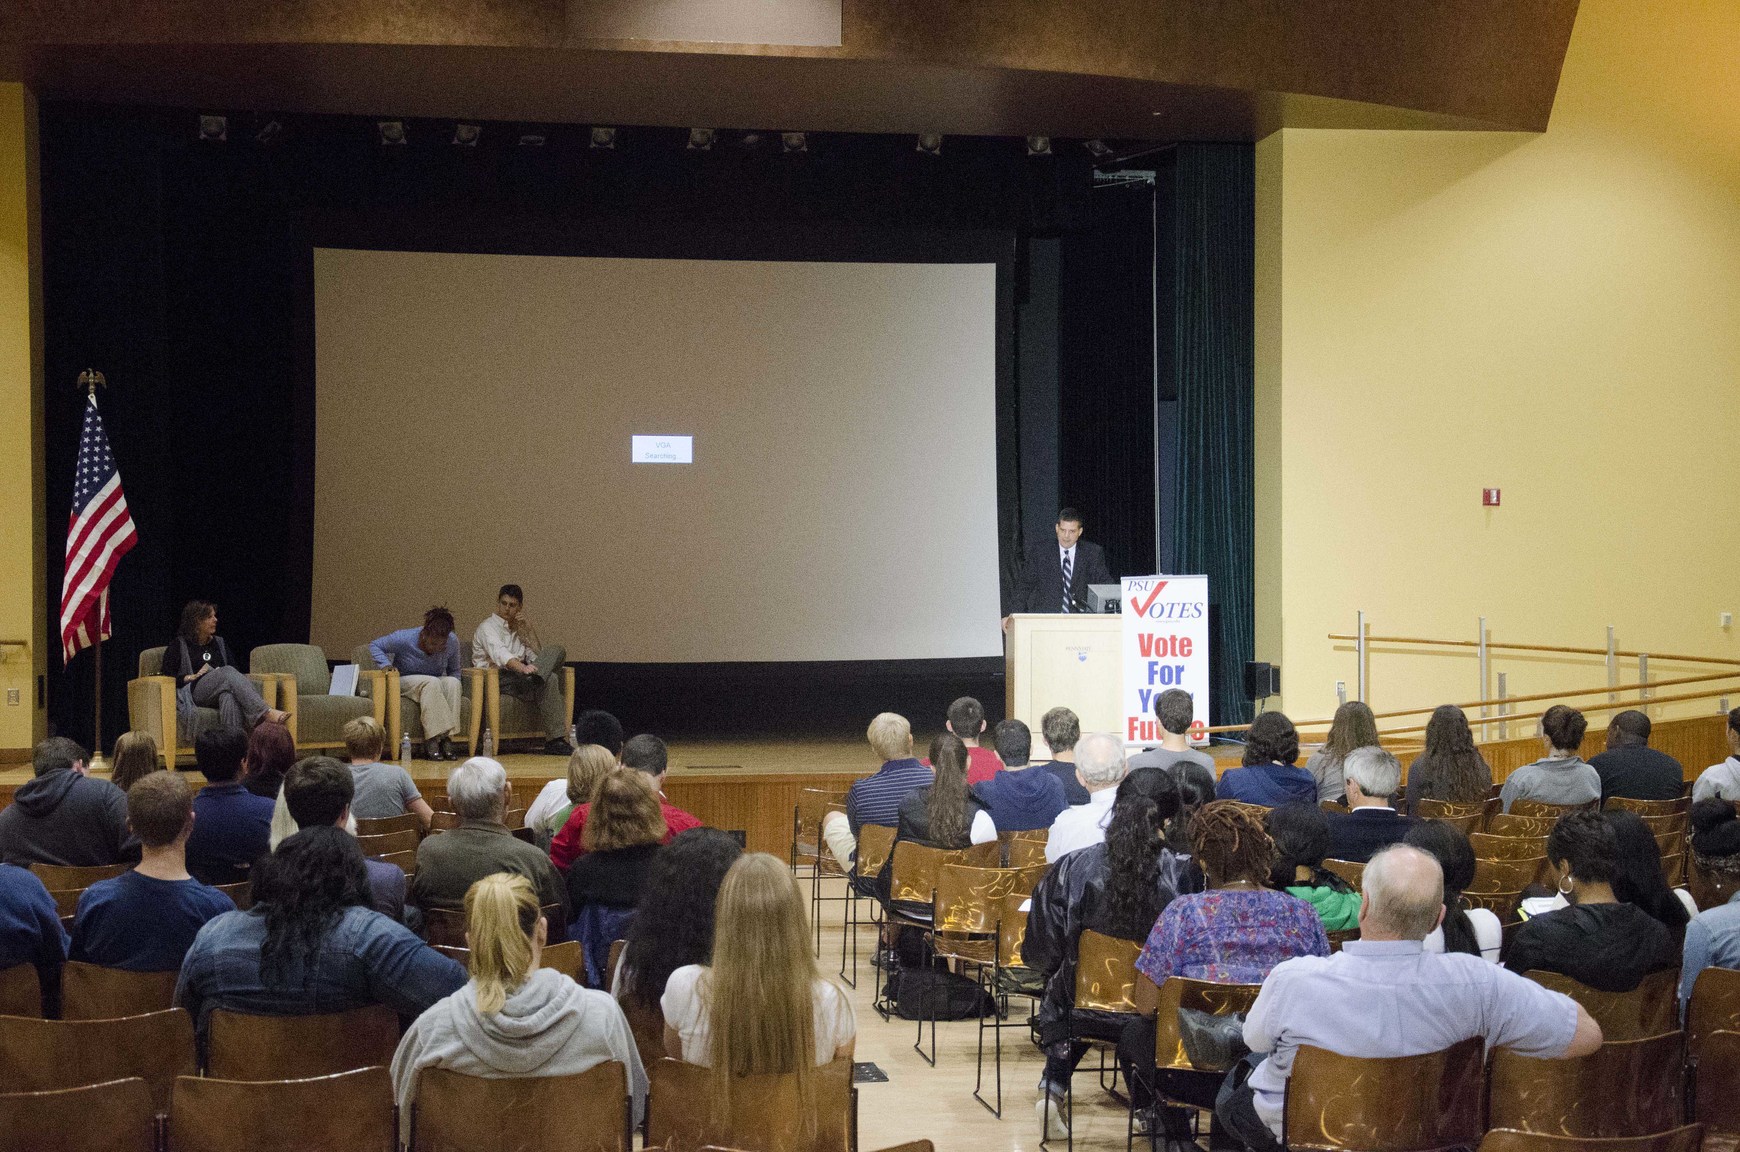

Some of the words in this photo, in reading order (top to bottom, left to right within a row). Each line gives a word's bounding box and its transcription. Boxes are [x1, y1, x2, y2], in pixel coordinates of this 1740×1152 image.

[1128, 581, 1154, 591] PSU
[1138, 633, 1193, 657] Vote
[1148, 661, 1185, 685] For
[1128, 717, 1204, 741] Fute
